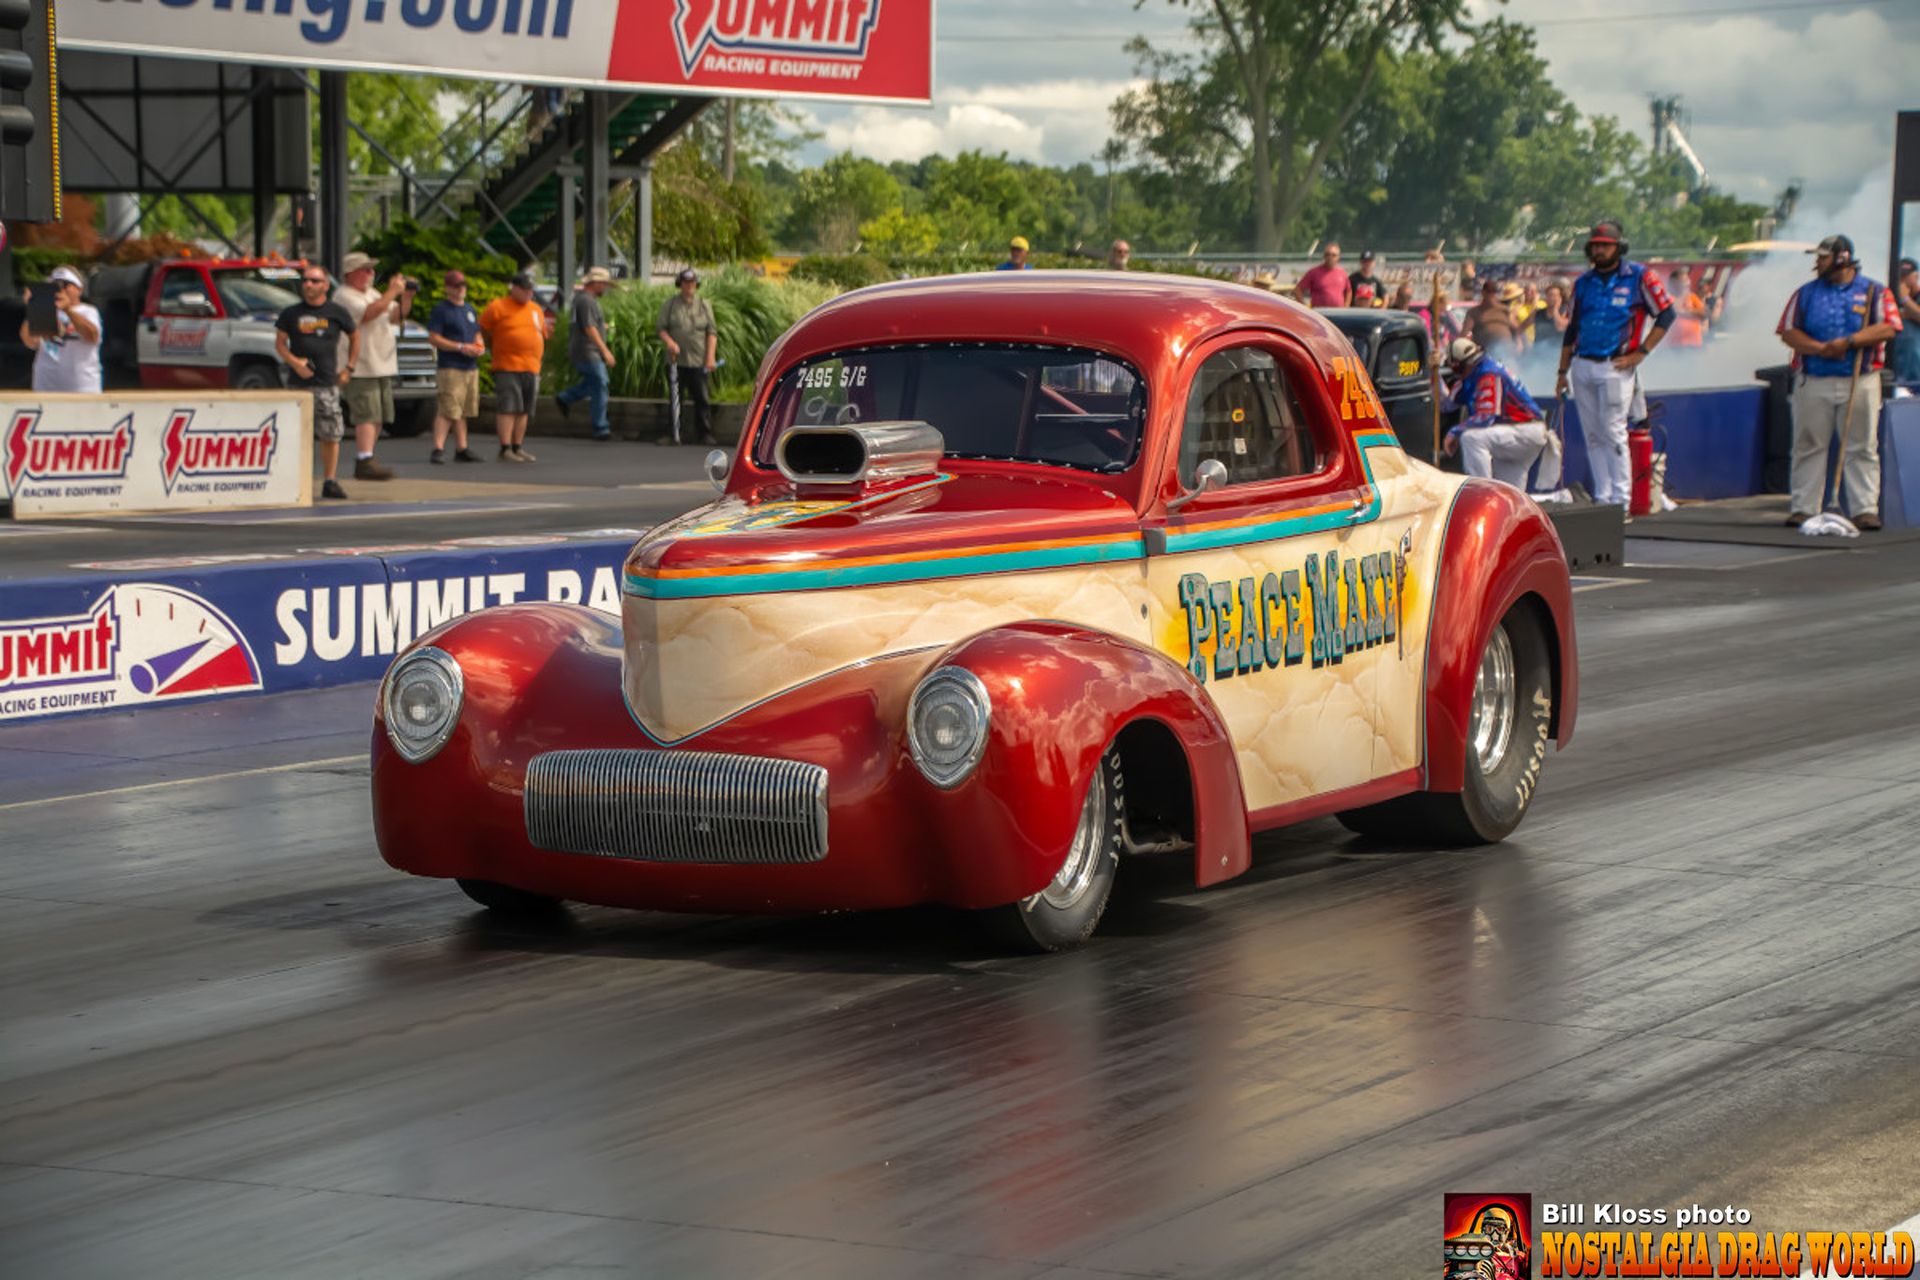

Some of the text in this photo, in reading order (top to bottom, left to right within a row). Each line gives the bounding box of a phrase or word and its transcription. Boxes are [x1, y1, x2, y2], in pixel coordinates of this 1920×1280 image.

[704, 55, 863, 79] RACING EQUIPMENT
[796, 366, 867, 389] 7495 S/G
[22, 485, 123, 498] RACING EQUIPMENT
[177, 480, 268, 493] RACING EQUIPMENT
[1179, 572, 1305, 684] PEACE
[41, 690, 117, 710] EQUIPMENT
